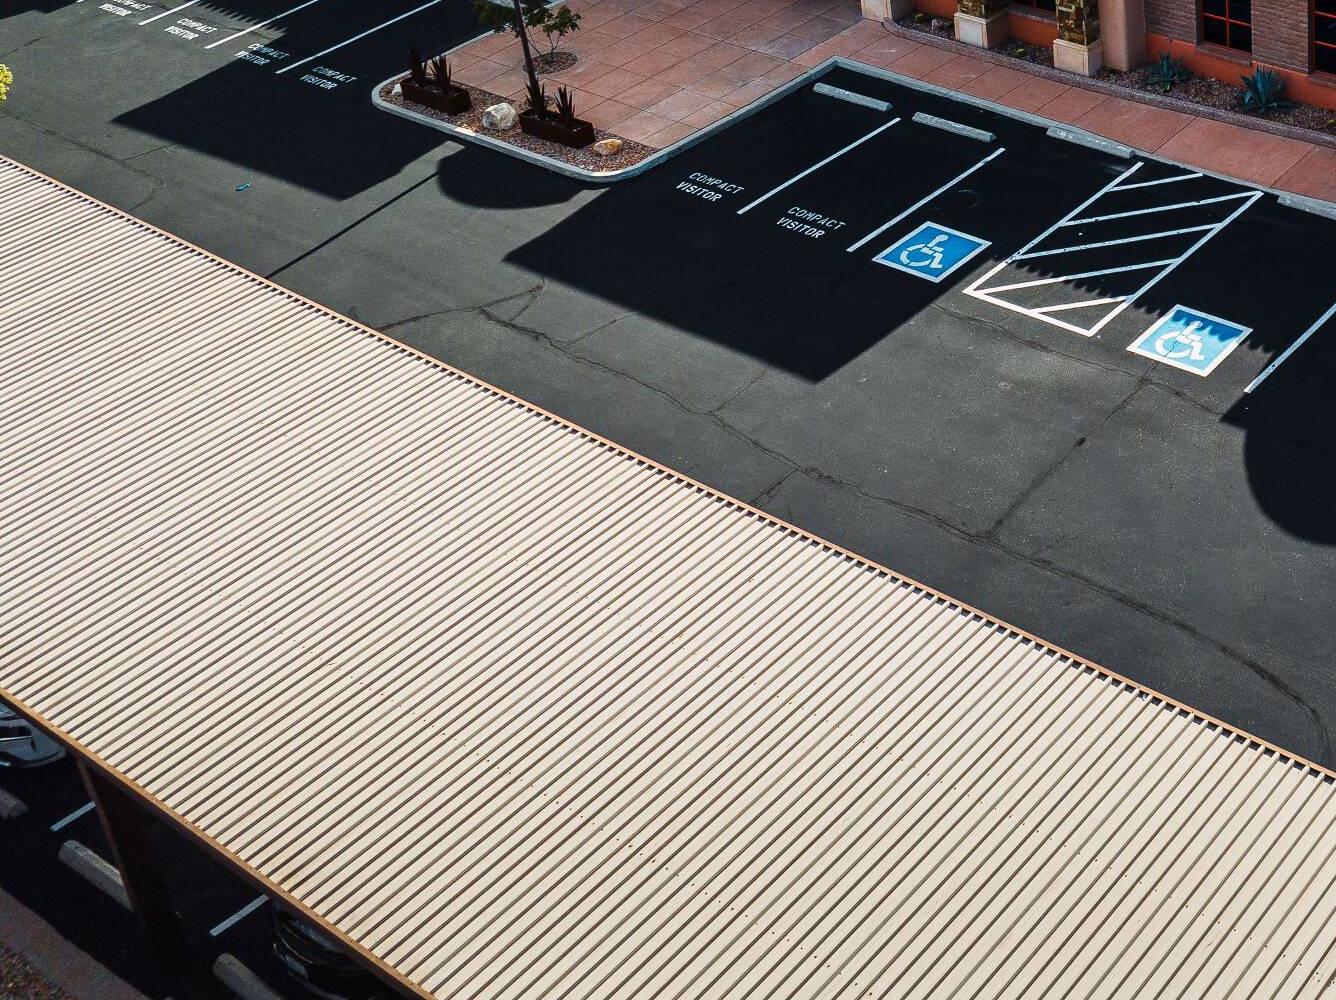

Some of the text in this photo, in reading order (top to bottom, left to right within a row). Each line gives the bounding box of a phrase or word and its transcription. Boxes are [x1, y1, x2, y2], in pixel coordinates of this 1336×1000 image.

[98, 3, 132, 17] VISITOR
[164, 25, 200, 40] VISITOR
[177, 18, 217, 33] COMPACT
[234, 50, 271, 66] VISITOR
[248, 43, 289, 58] COMPACT
[299, 74, 338, 90] VISITOR
[312, 66, 357, 83] COMPACT
[689, 172, 744, 194] COMPACT
[676, 181, 722, 202] VISITOR
[788, 206, 846, 229] COMPACT
[777, 217, 825, 238] VISITOR
